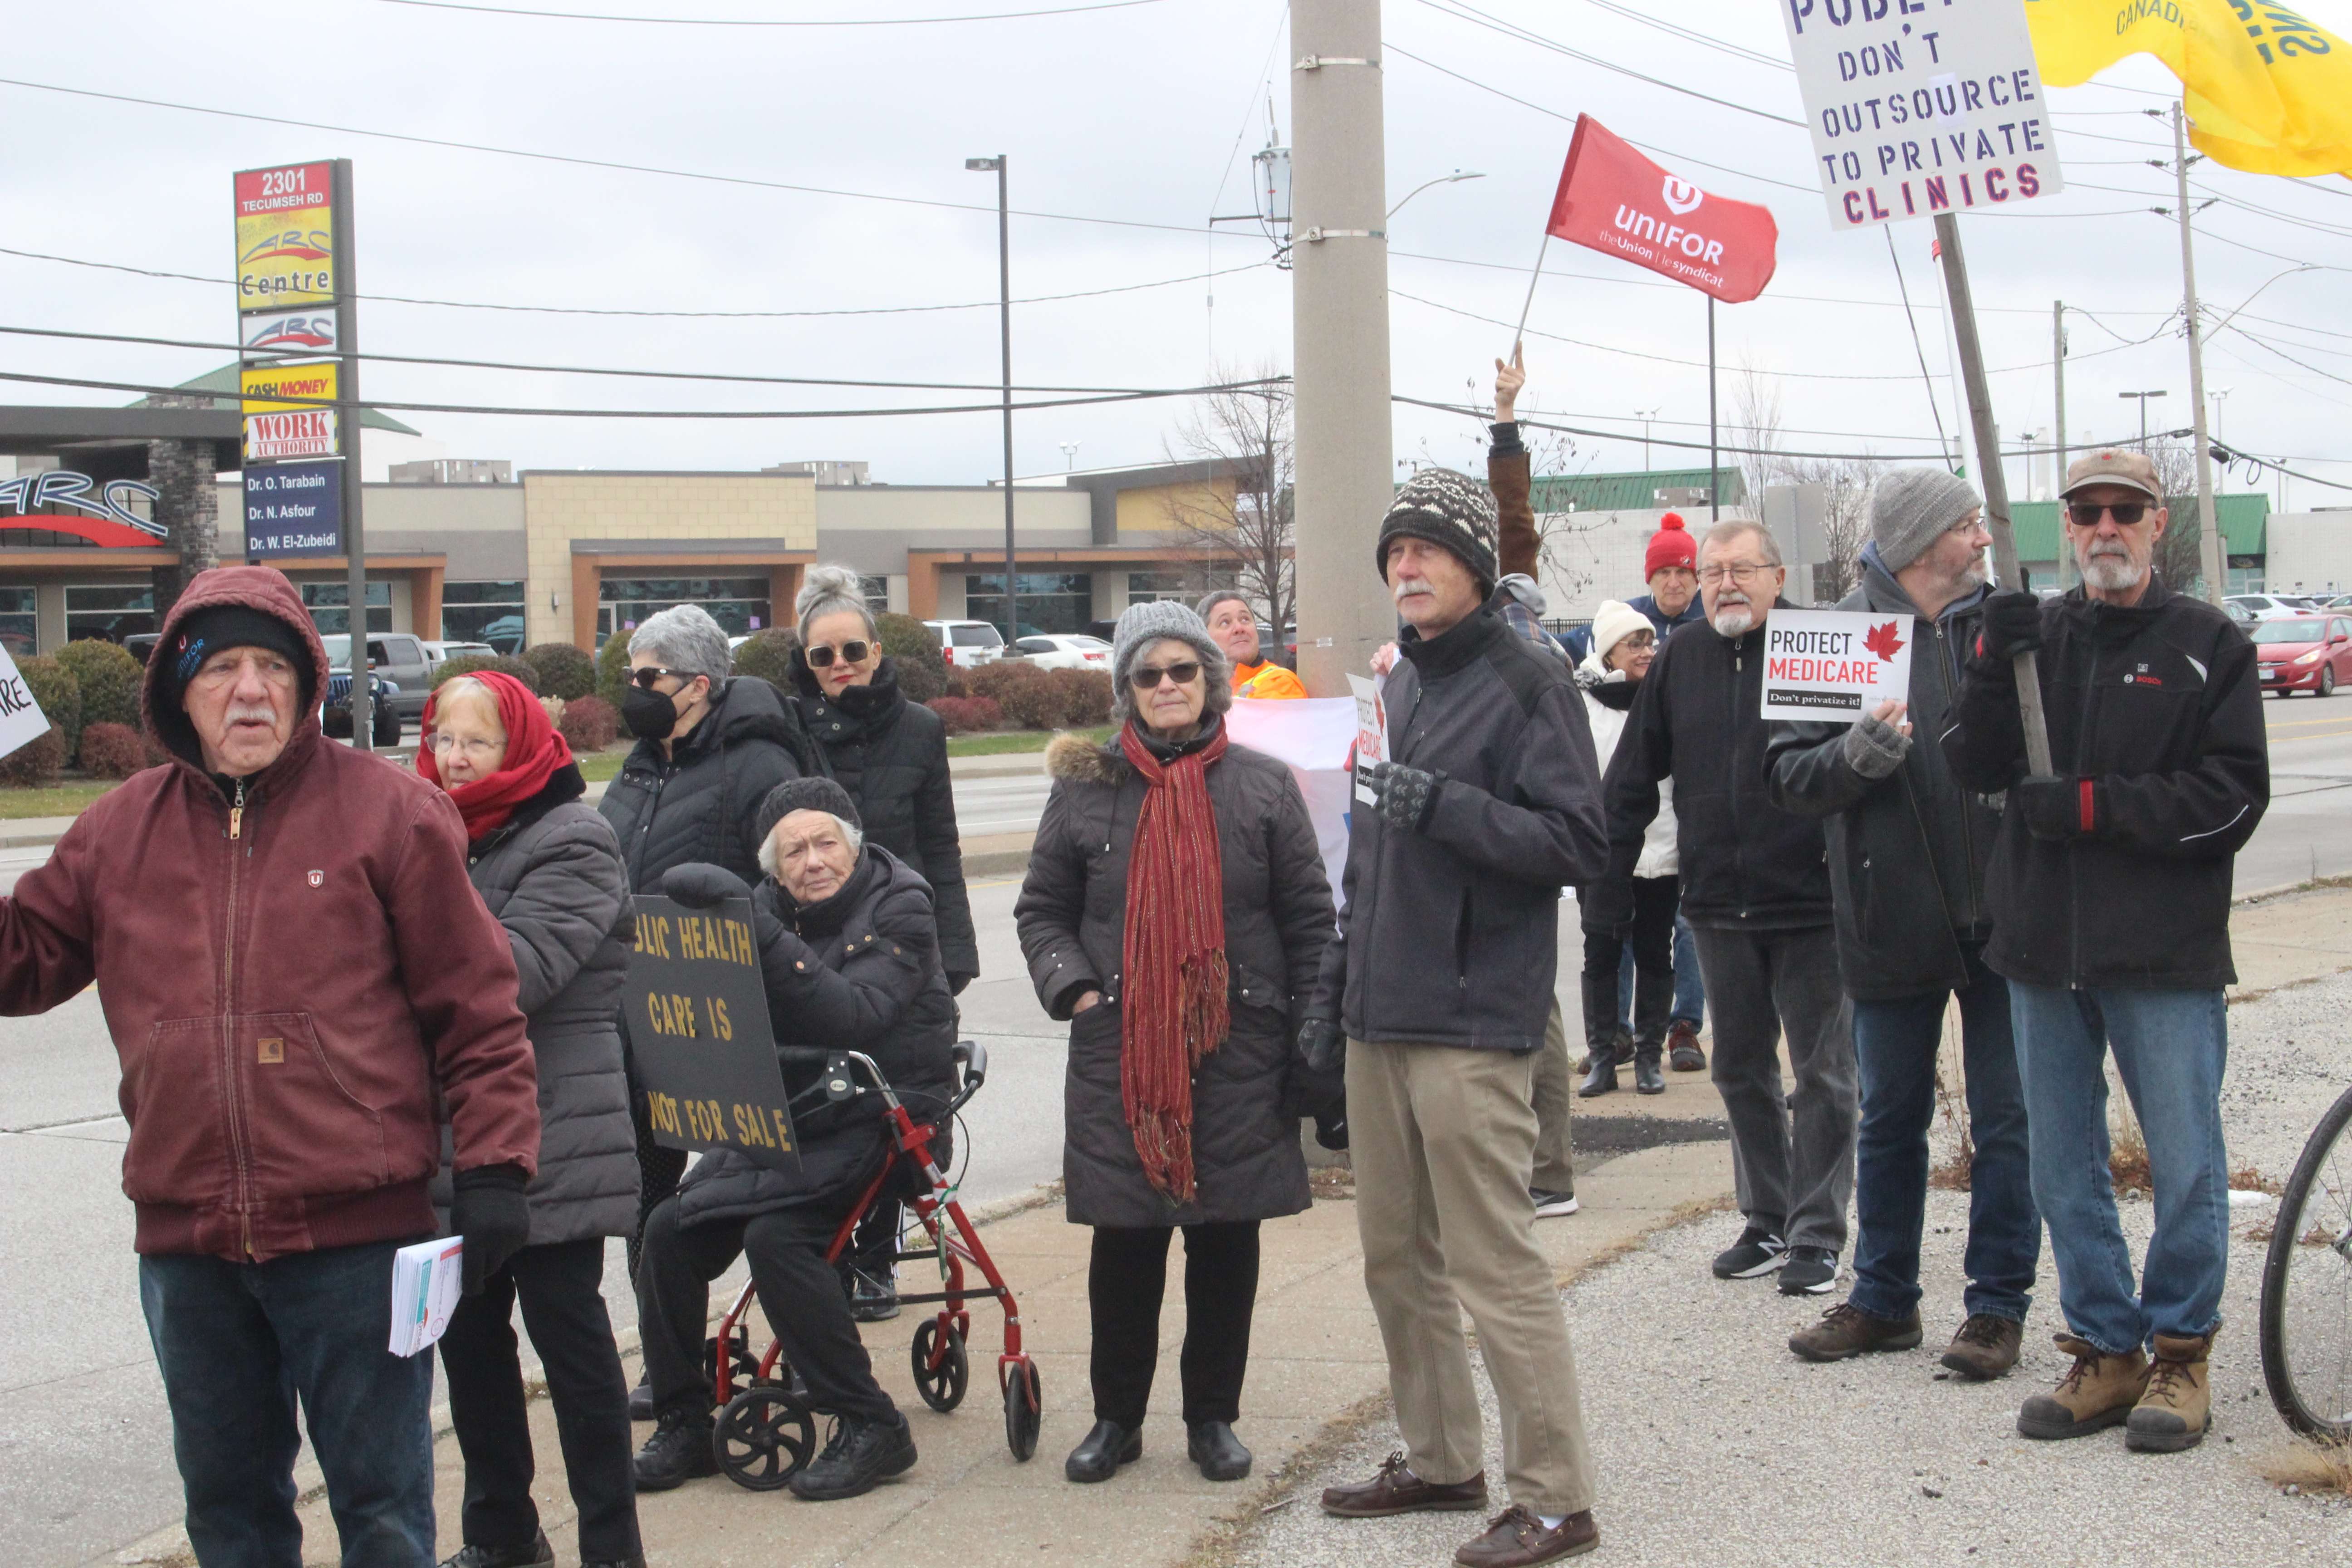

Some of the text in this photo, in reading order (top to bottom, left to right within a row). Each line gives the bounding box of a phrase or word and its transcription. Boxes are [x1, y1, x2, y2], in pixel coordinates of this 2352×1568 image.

[1790, 0, 1952, 34] PUB
[1838, 23, 1939, 82] DON'T
[1822, 69, 2035, 138] OUTSOURCE
[1822, 119, 2044, 184] TO PRIVATE
[262, 168, 305, 196] 2301
[1843, 163, 2040, 224] CLINICS
[243, 192, 323, 212] TECUMSEH RD
[240, 230, 332, 265] ARC
[241, 271, 329, 296] Centre
[246, 317, 335, 346] ARC
[255, 412, 328, 441] WORK
[256, 440, 328, 457] AUTHORITY
[248, 475, 325, 491] Dr. O. Tarabain
[249, 505, 315, 520] Dr. N. Asfour
[250, 533, 336, 550] Dr. W. El-Zubeidi
[1770, 630, 1852, 655] PROTECT
[1769, 657, 1878, 684] MEDICARE
[0, 675, 31, 717] RE
[1770, 693, 1799, 703] Don't
[1802, 696, 1846, 706] privatize
[1849, 697, 1860, 706] it!
[678, 916, 753, 966] HEALTH
[648, 992, 732, 1041] CARE IS
[647, 1091, 791, 1152] NOT FOR SALE
